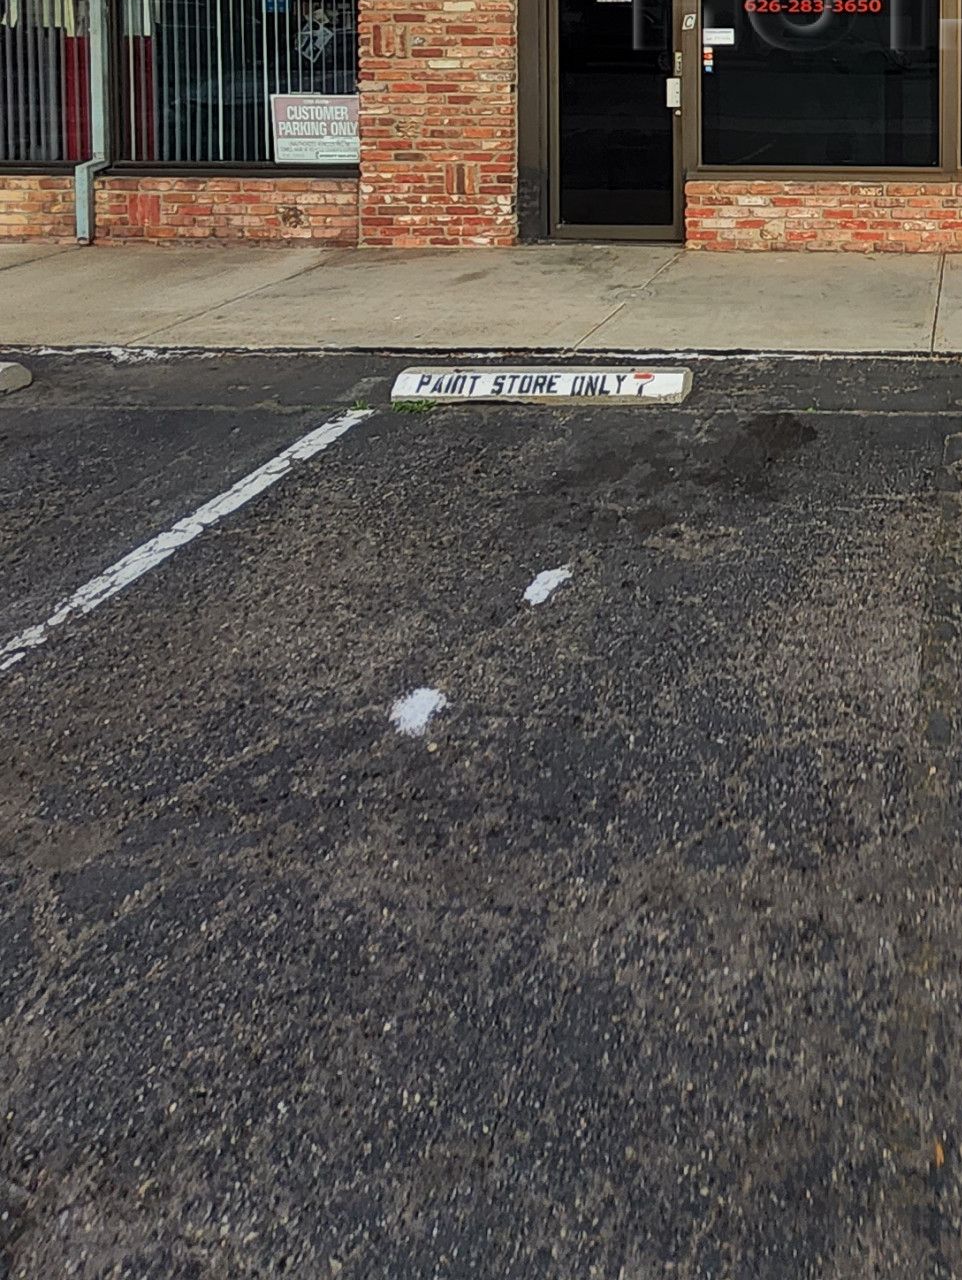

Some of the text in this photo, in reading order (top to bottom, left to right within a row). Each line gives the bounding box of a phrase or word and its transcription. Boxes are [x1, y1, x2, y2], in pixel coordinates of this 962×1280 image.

[684, 15, 694, 28] C
[287, 106, 349, 120] CUSTOMER
[278, 121, 358, 136] PARKING ONLY
[415, 373, 627, 397] PAINT STORE ONLY
